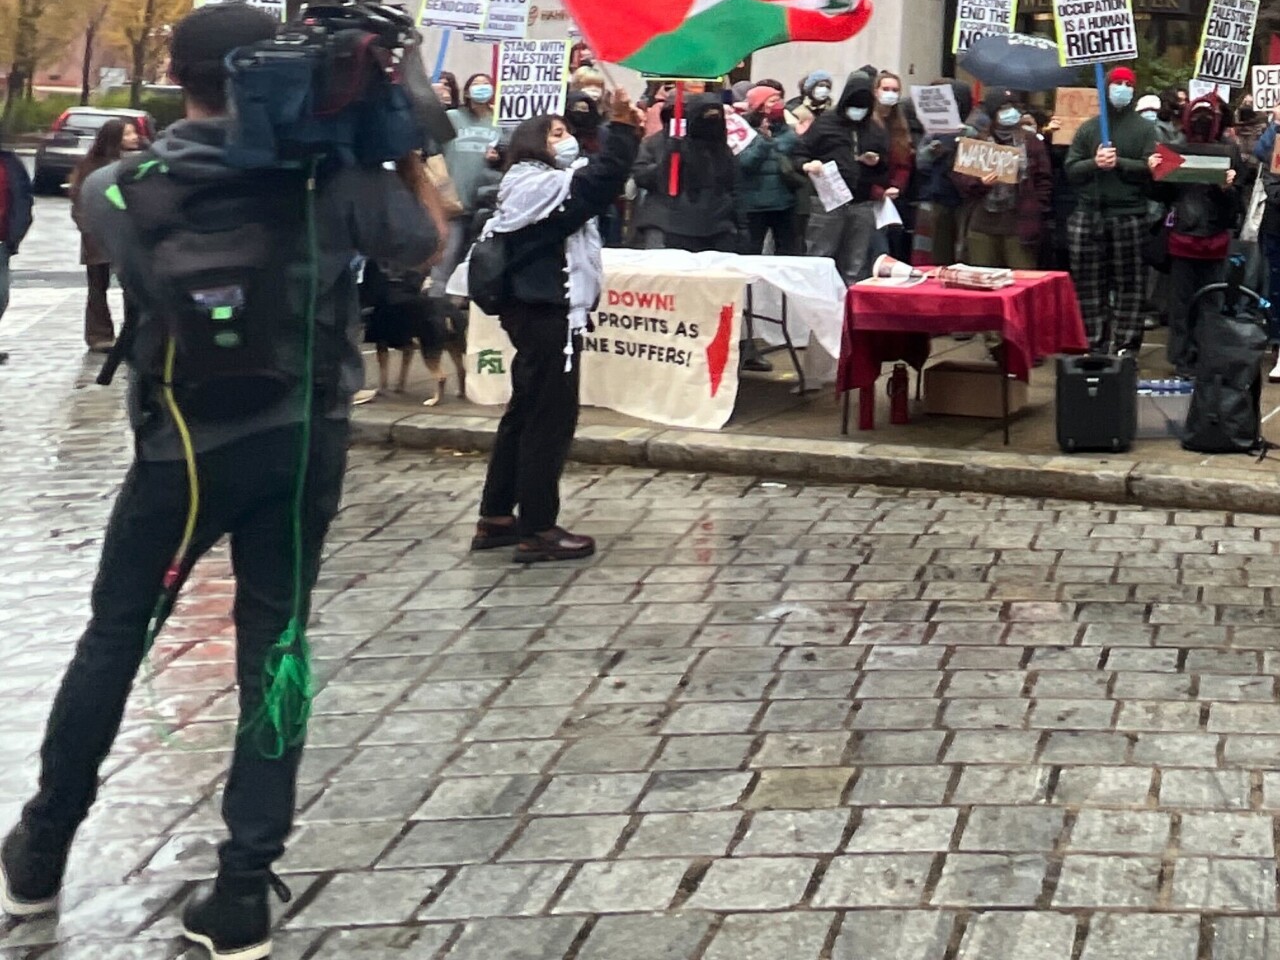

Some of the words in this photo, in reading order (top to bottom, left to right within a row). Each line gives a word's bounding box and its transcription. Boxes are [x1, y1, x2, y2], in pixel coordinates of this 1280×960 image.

[960, 6, 986, 20] END
[989, 8, 1011, 24] THE
[1064, 19, 1076, 33] IS
[1078, 19, 1086, 30] A
[1088, 13, 1129, 30] HUMAN
[1066, 27, 1133, 57] RIGHT!
[1207, 20, 1231, 38] END
[1234, 24, 1252, 43] THE
[503, 40, 537, 52] STAND
[540, 41, 566, 52] WITH
[502, 53, 564, 65] PALESTINE!
[1200, 50, 1245, 80] NOW!
[501, 65, 531, 81] END
[535, 65, 563, 81] THE
[500, 83, 562, 95] OCCUPATION
[499, 95, 561, 119] NOW!
[607, 289, 677, 312] DOWN!
[599, 312, 669, 335] PROFITS
[674, 321, 700, 339] AS
[614, 340, 692, 367] SUFFERS!
